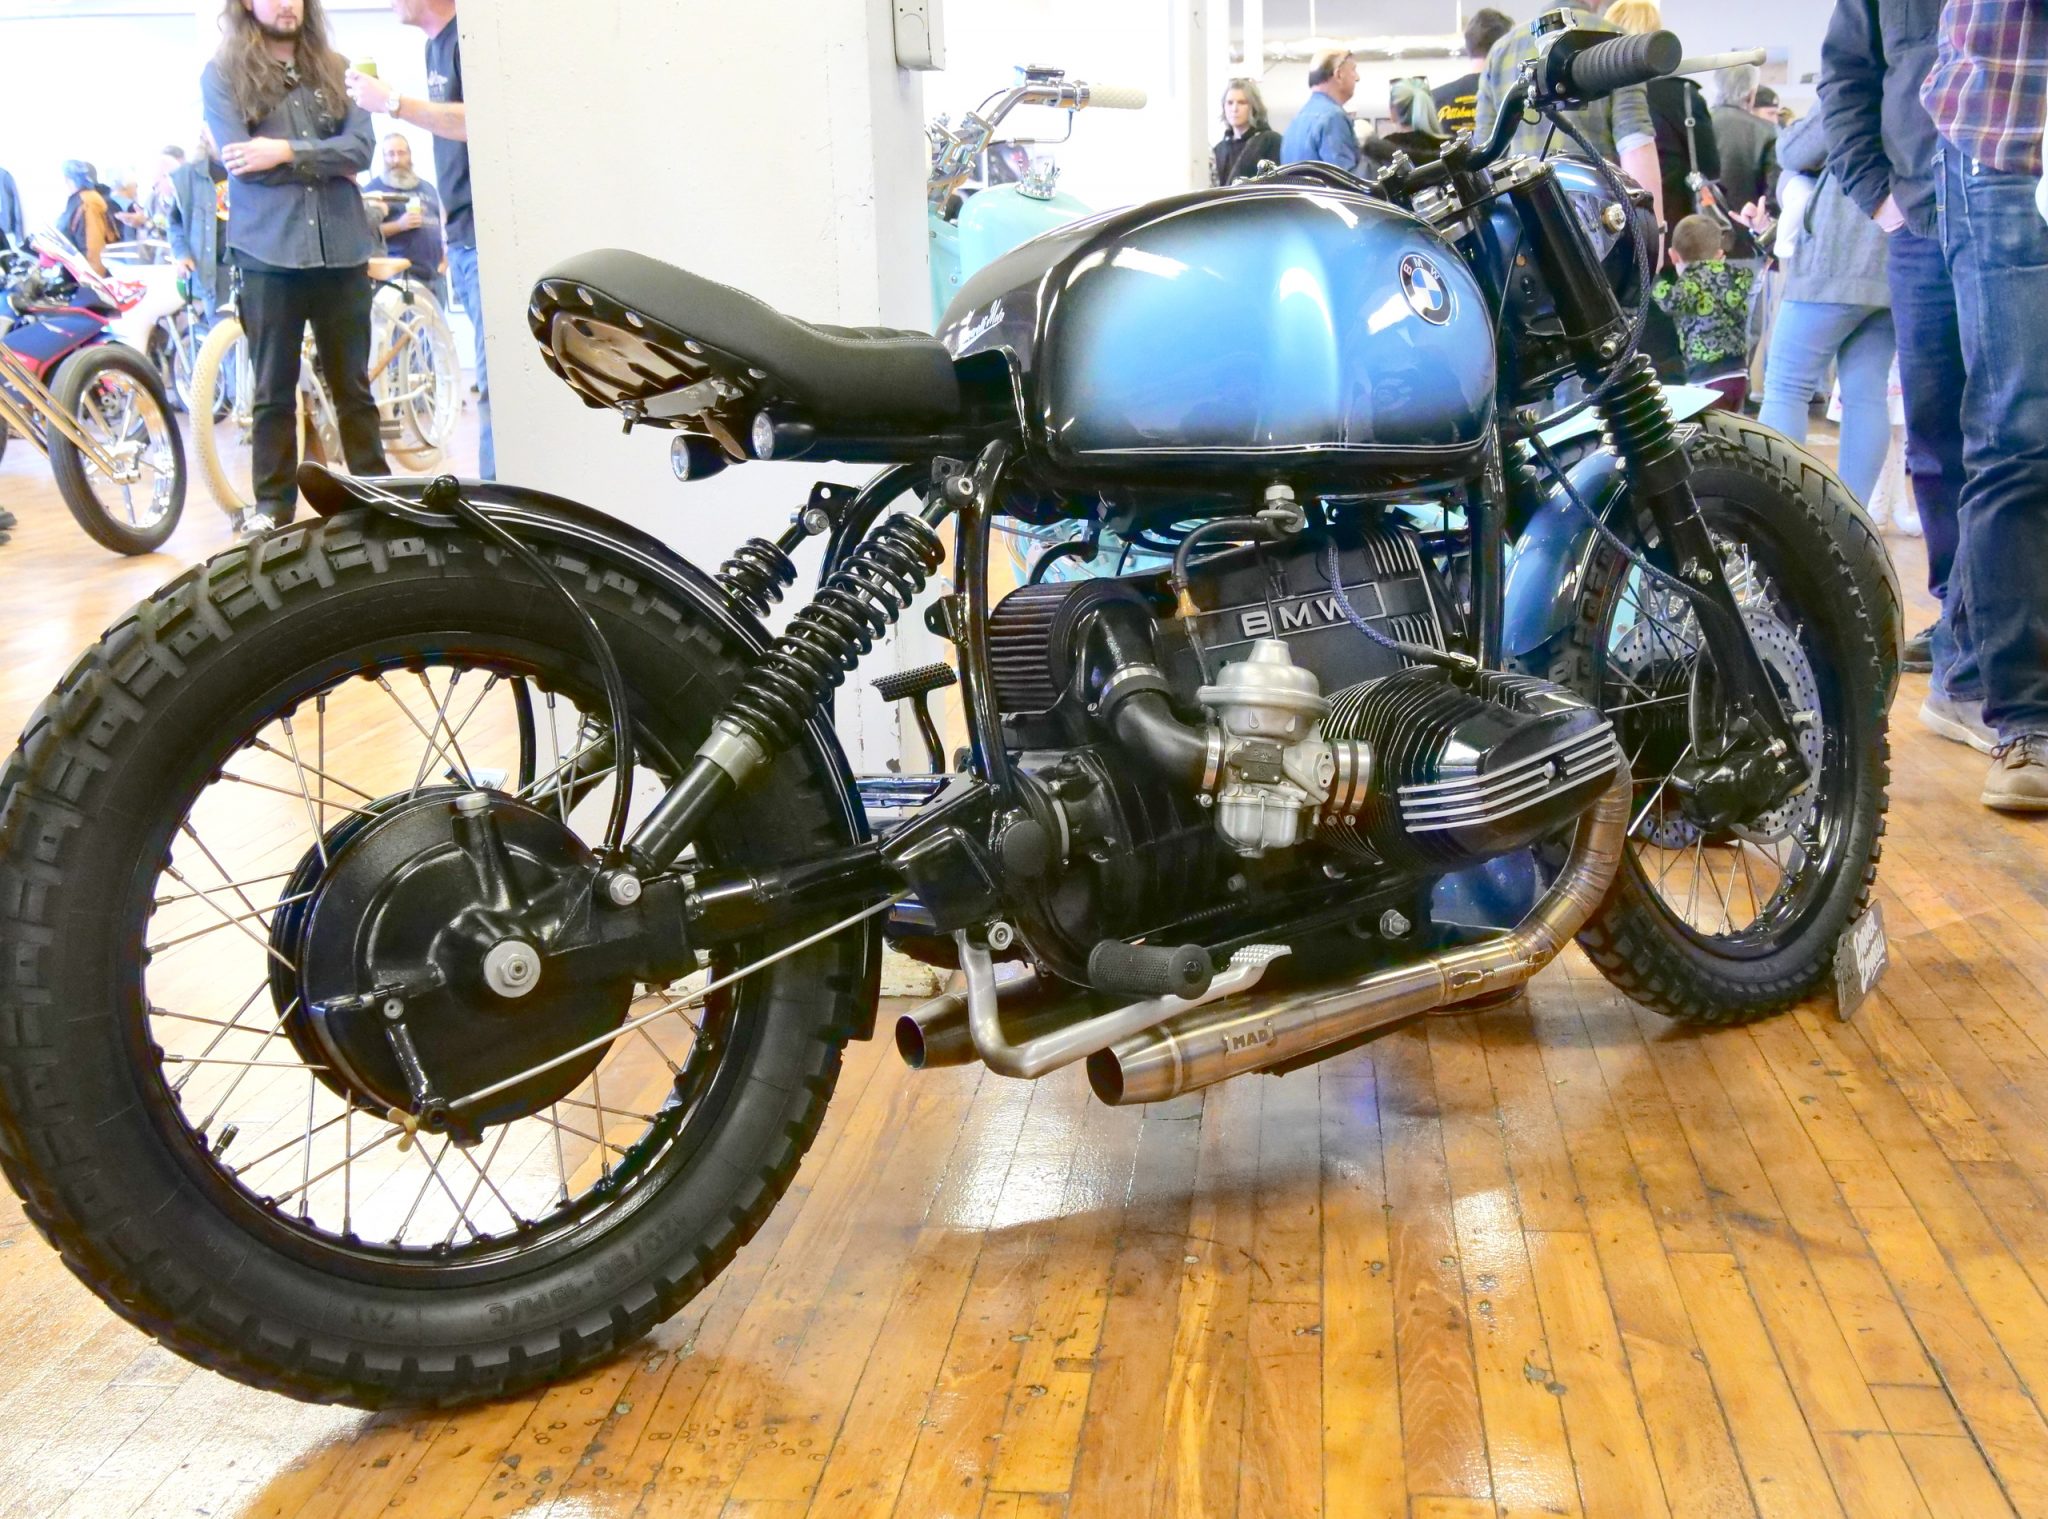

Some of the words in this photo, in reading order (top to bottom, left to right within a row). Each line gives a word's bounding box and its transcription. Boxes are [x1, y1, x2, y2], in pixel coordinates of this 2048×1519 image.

[1403, 257, 1440, 280] BMW
[1240, 595, 1349, 637] BMW
[1232, 1029, 1269, 1050] MAD
